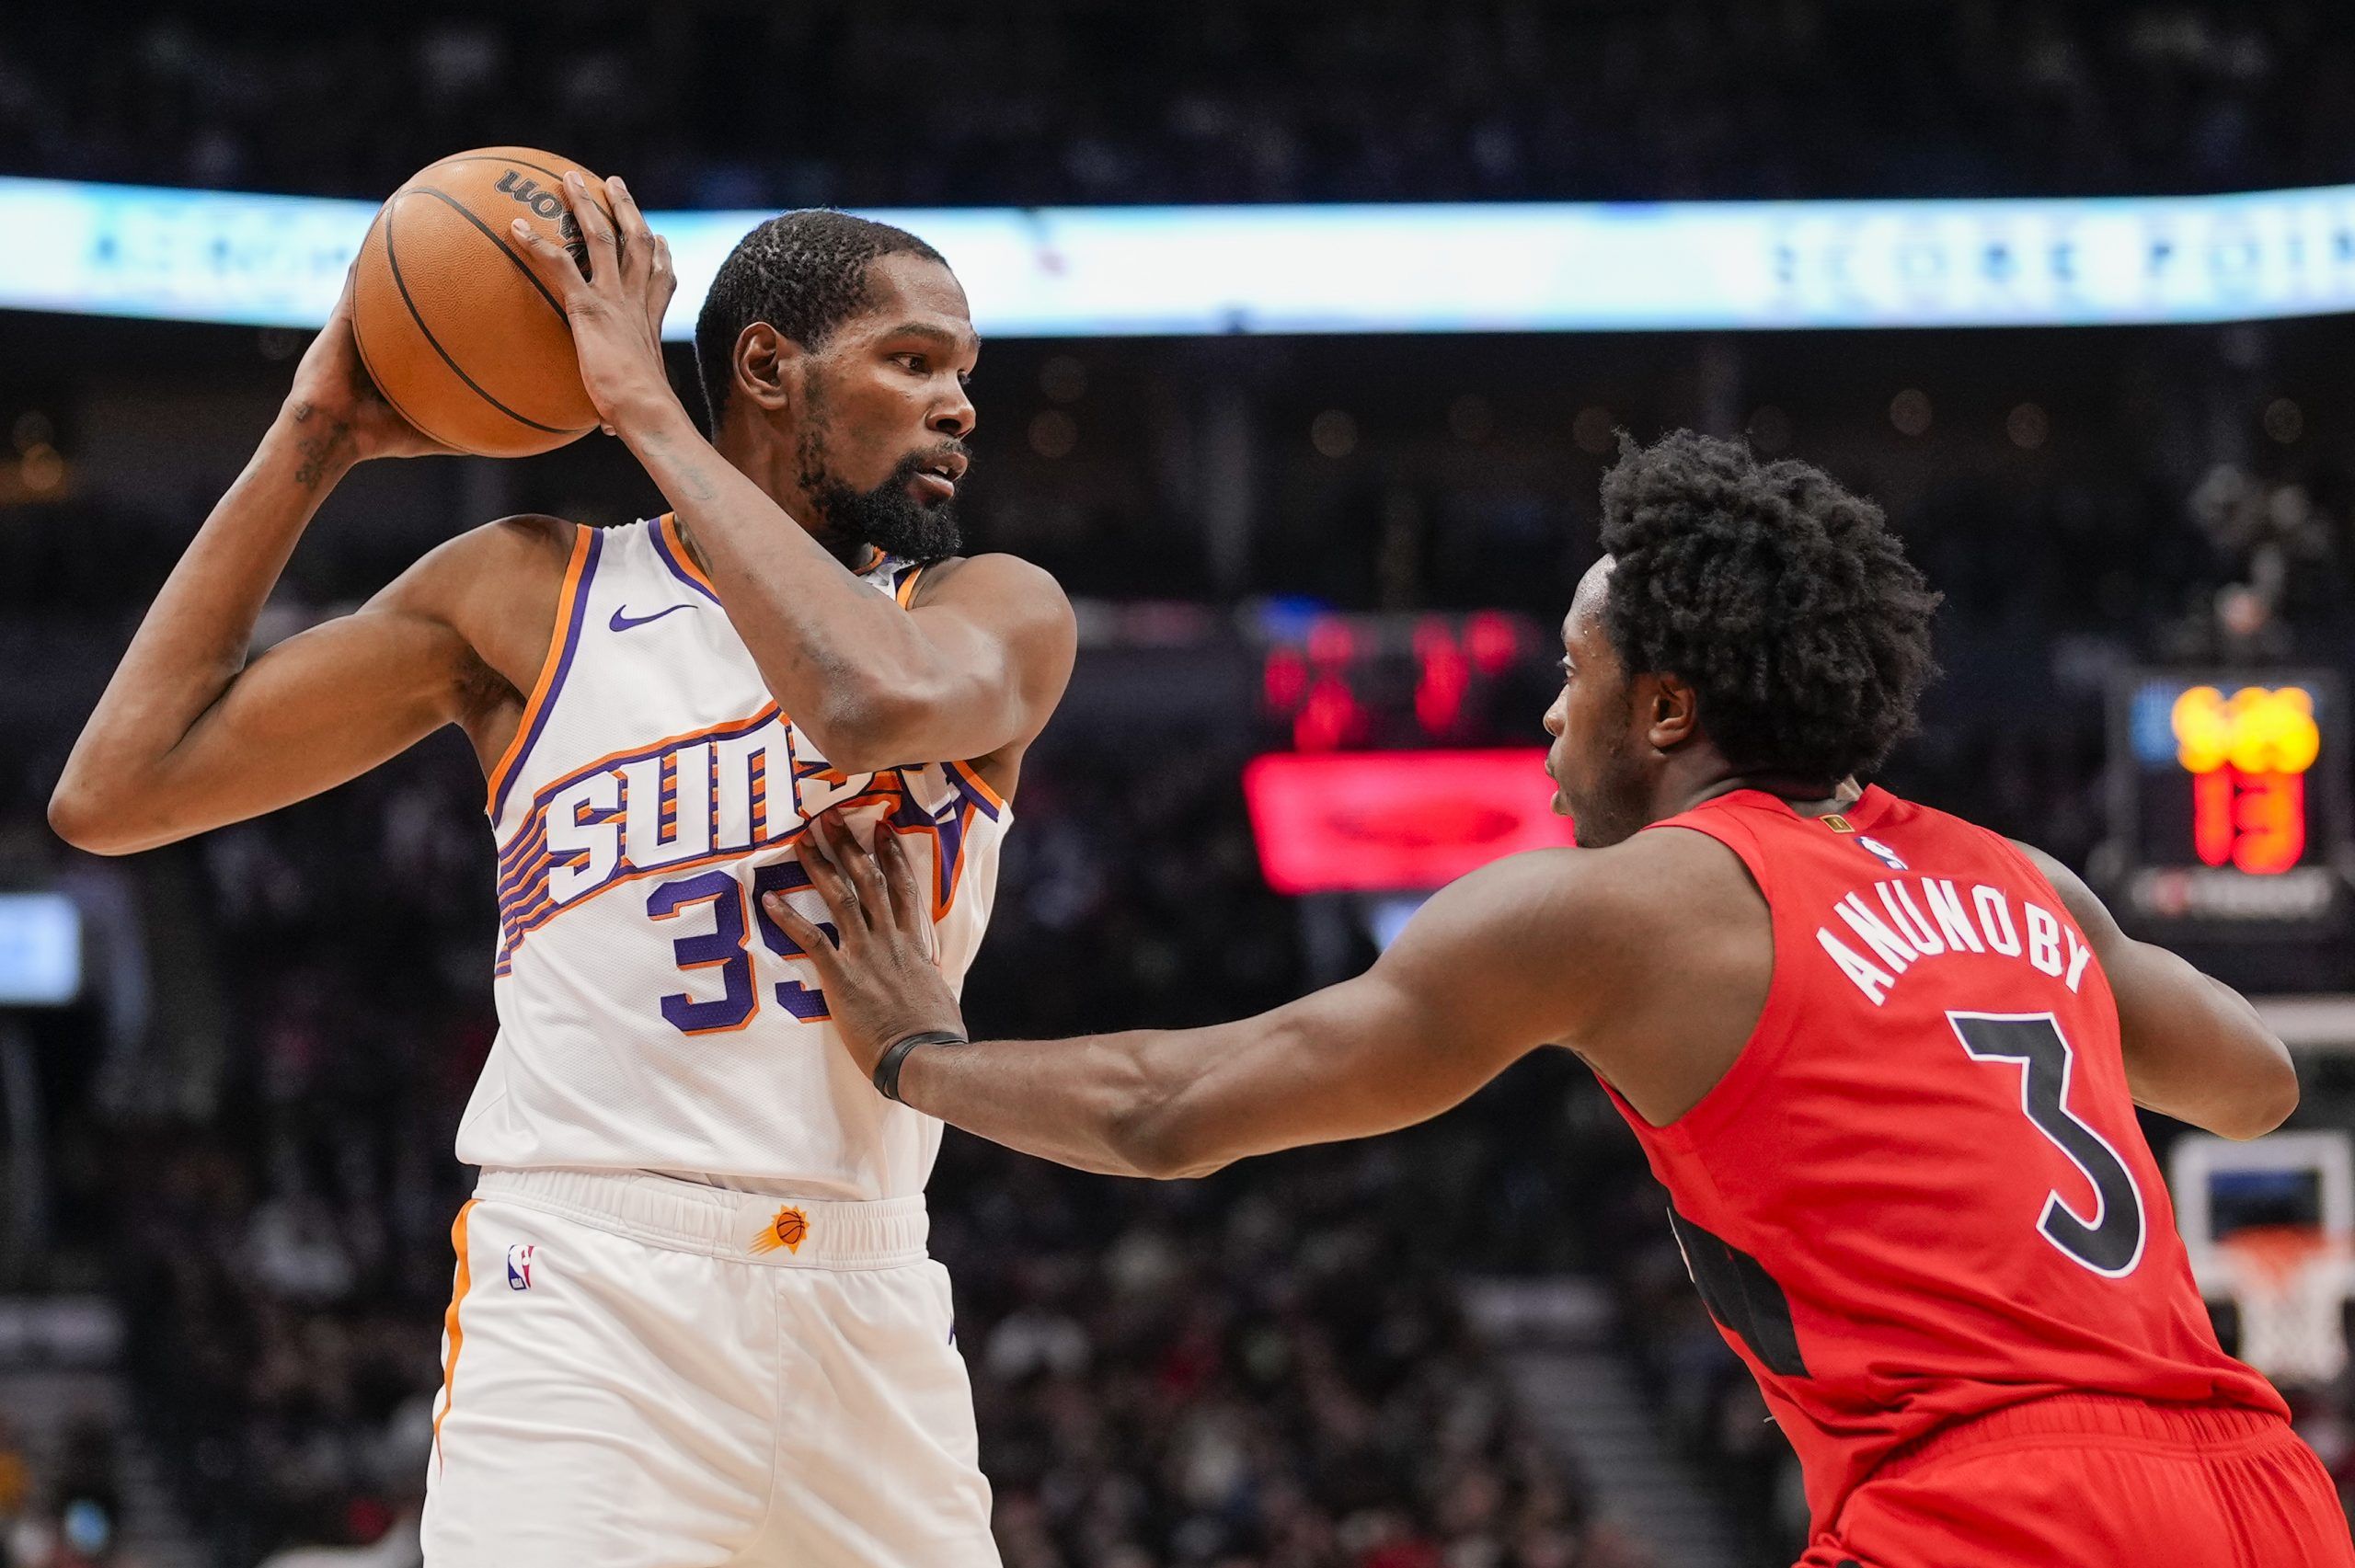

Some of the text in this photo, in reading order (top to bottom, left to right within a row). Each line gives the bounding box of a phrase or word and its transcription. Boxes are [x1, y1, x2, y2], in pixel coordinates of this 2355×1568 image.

[646, 861, 841, 1037] 35
[1816, 876, 2091, 1007] ANUNOBY
[1944, 1010, 2147, 1279] 3
